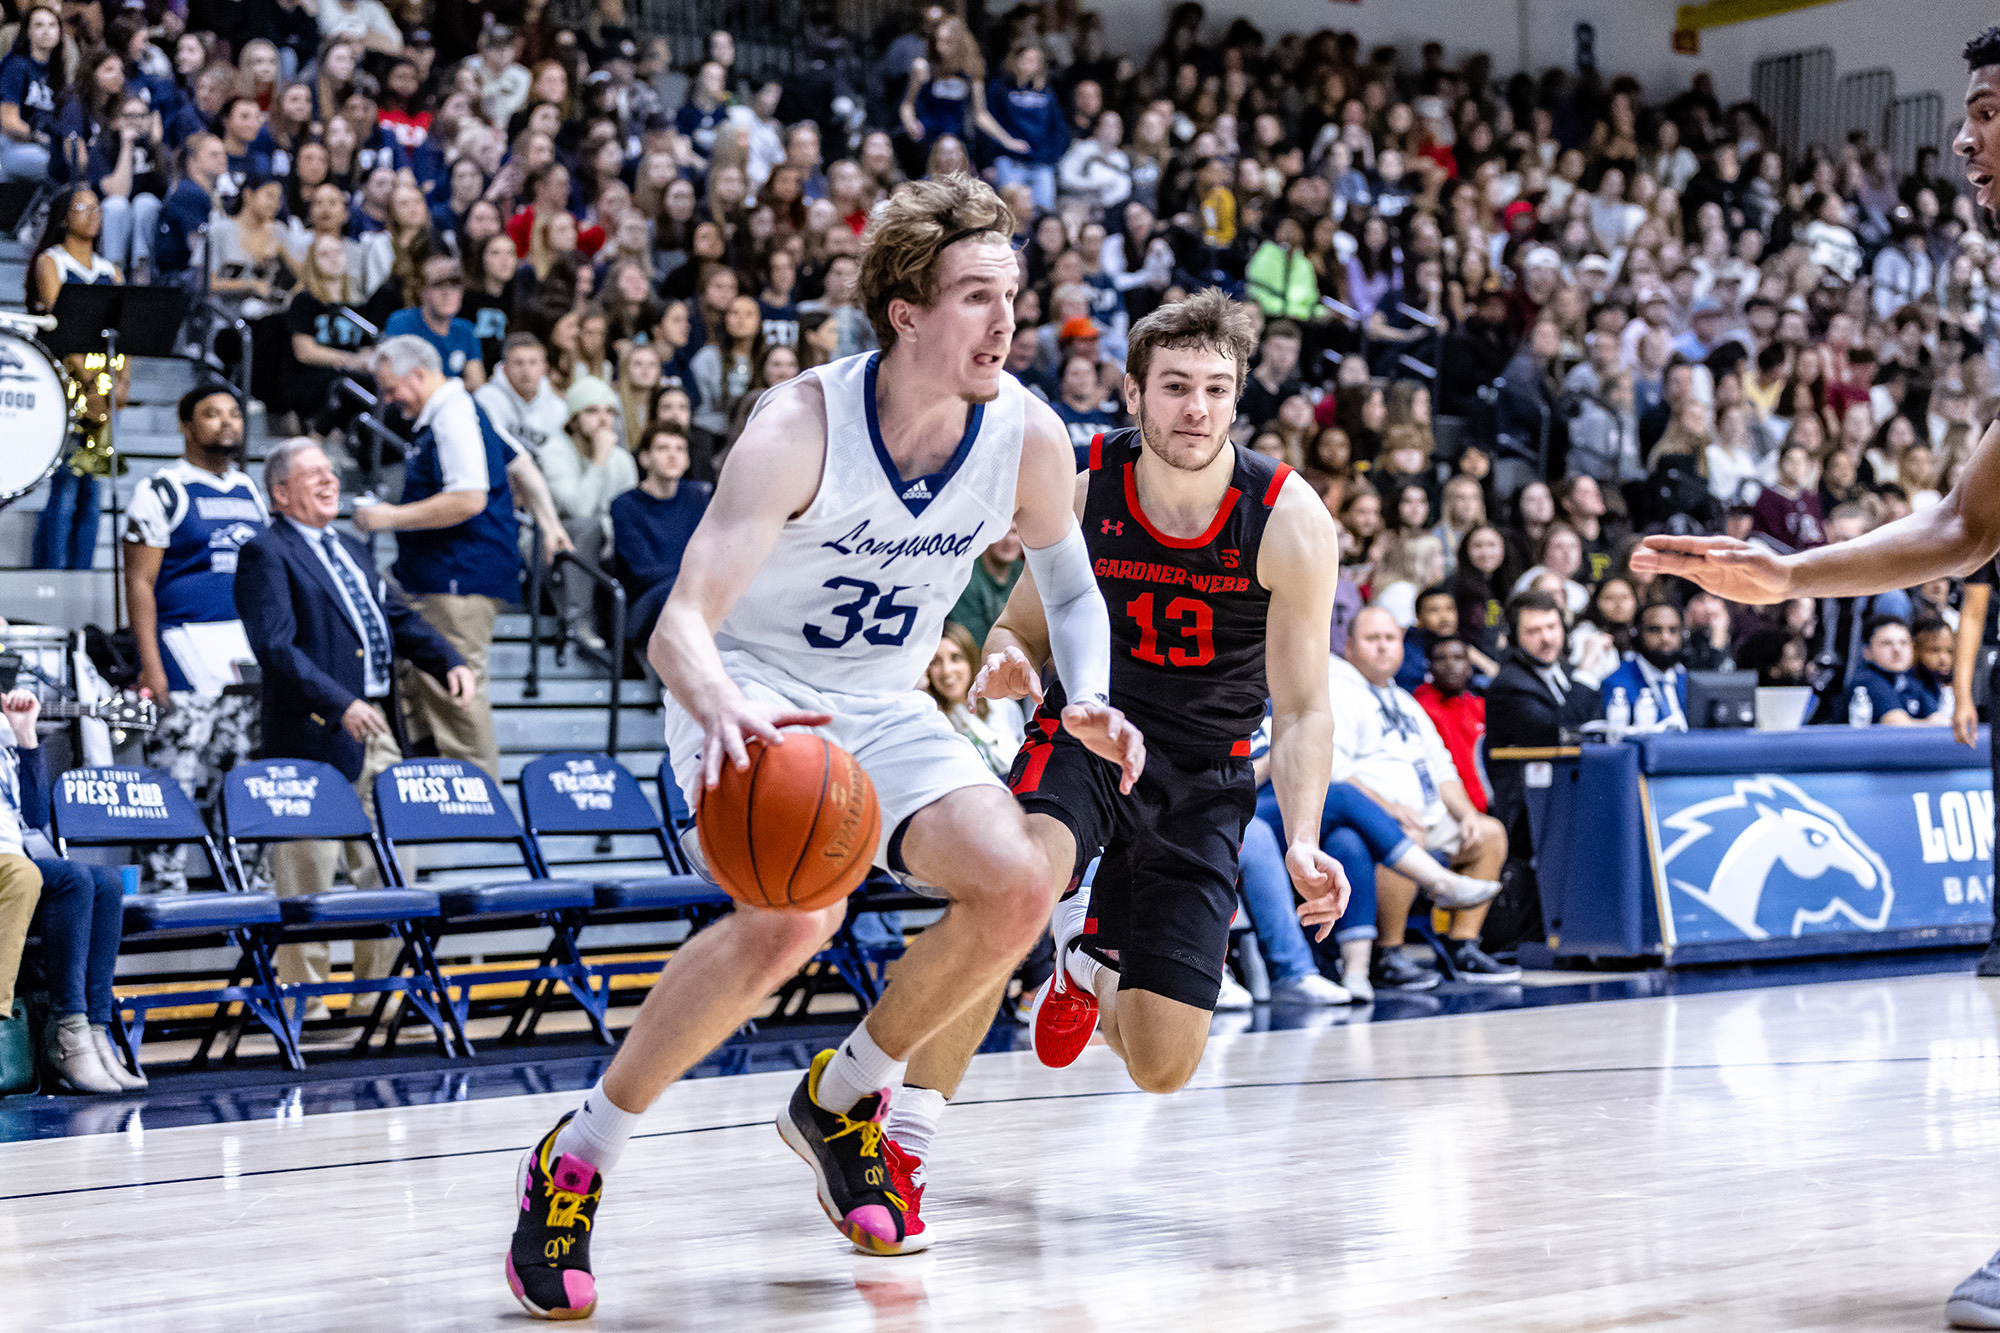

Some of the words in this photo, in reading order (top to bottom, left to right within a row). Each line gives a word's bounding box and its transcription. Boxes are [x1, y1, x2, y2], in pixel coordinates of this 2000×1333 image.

[902, 490, 932, 500] adidas
[821, 519, 985, 570] Longwood
[1094, 558, 1250, 594] GARDNER-WEBB
[802, 576, 930, 649] 35
[1126, 592, 1215, 667] 13
[64, 780, 120, 805] PRESS
[396, 777, 450, 803] PRESS
